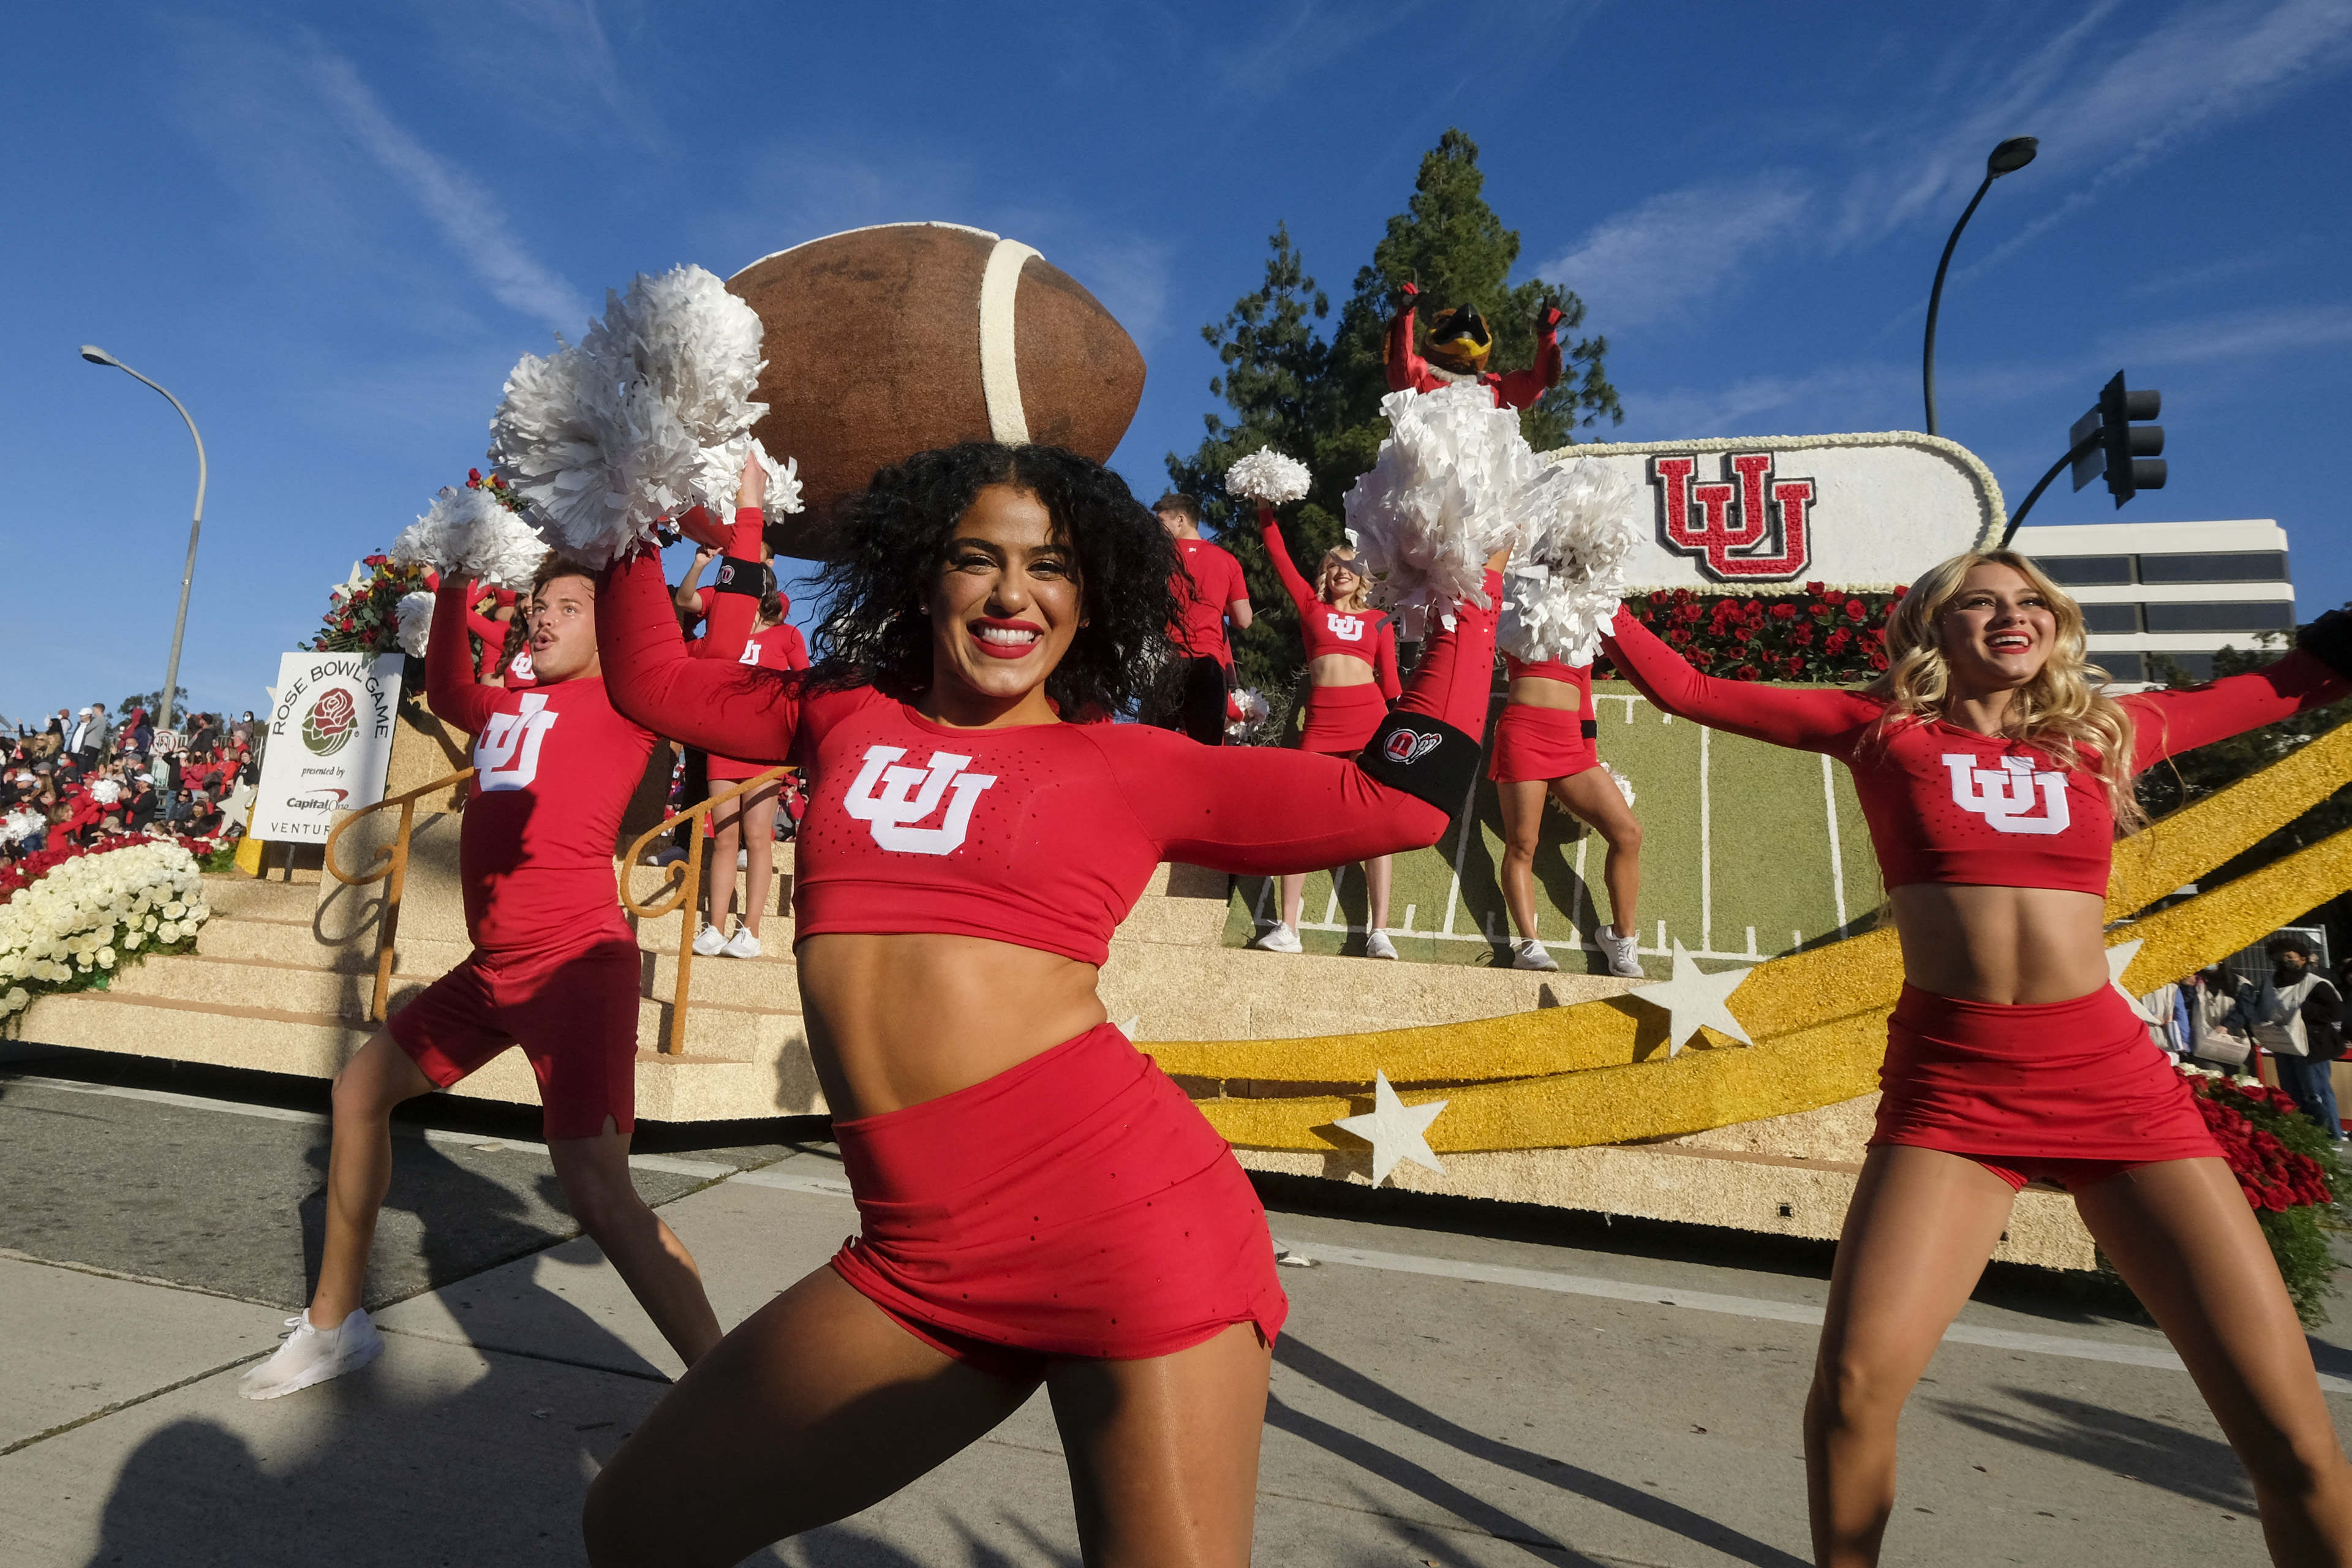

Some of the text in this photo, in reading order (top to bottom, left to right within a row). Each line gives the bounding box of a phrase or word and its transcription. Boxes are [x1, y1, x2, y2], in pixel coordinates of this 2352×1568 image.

[273, 660, 390, 739] ROSE BOWL GAME
[301, 766, 345, 778] presented by
